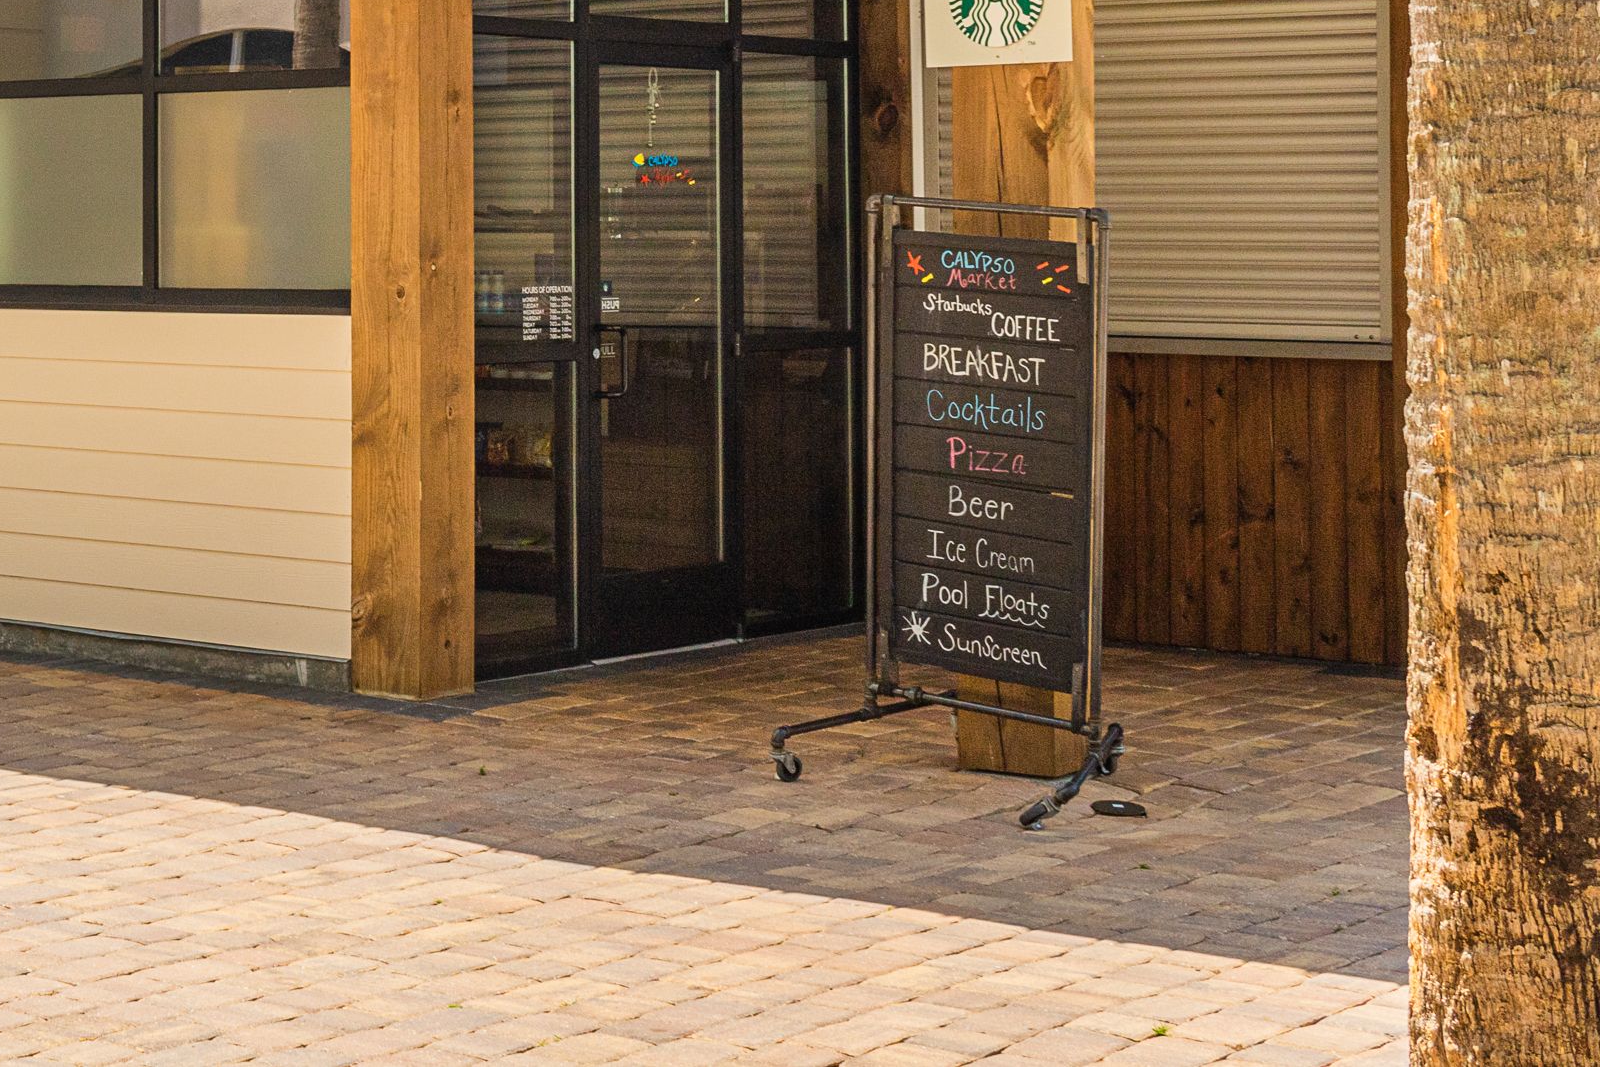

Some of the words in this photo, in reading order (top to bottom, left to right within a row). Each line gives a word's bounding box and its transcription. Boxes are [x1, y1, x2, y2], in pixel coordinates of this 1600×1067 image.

[941, 250, 1016, 275] CALYPSO
[946, 268, 1017, 291] Market
[522, 286, 538, 294] HOURS
[546, 285, 572, 294] OPERATION
[923, 292, 993, 316] Starbucks
[990, 312, 1061, 342] COFFEE
[600, 345, 615, 355] ULL
[923, 342, 1046, 386] BREAKFAST
[926, 389, 1046, 433] Cocktails
[946, 436, 1027, 475] Pizza
[948, 485, 1014, 521] Beer
[926, 529, 966, 563] Ice
[976, 538, 1035, 573] Cream
[921, 572, 968, 609] Pool
[985, 584, 1050, 620] Floats
